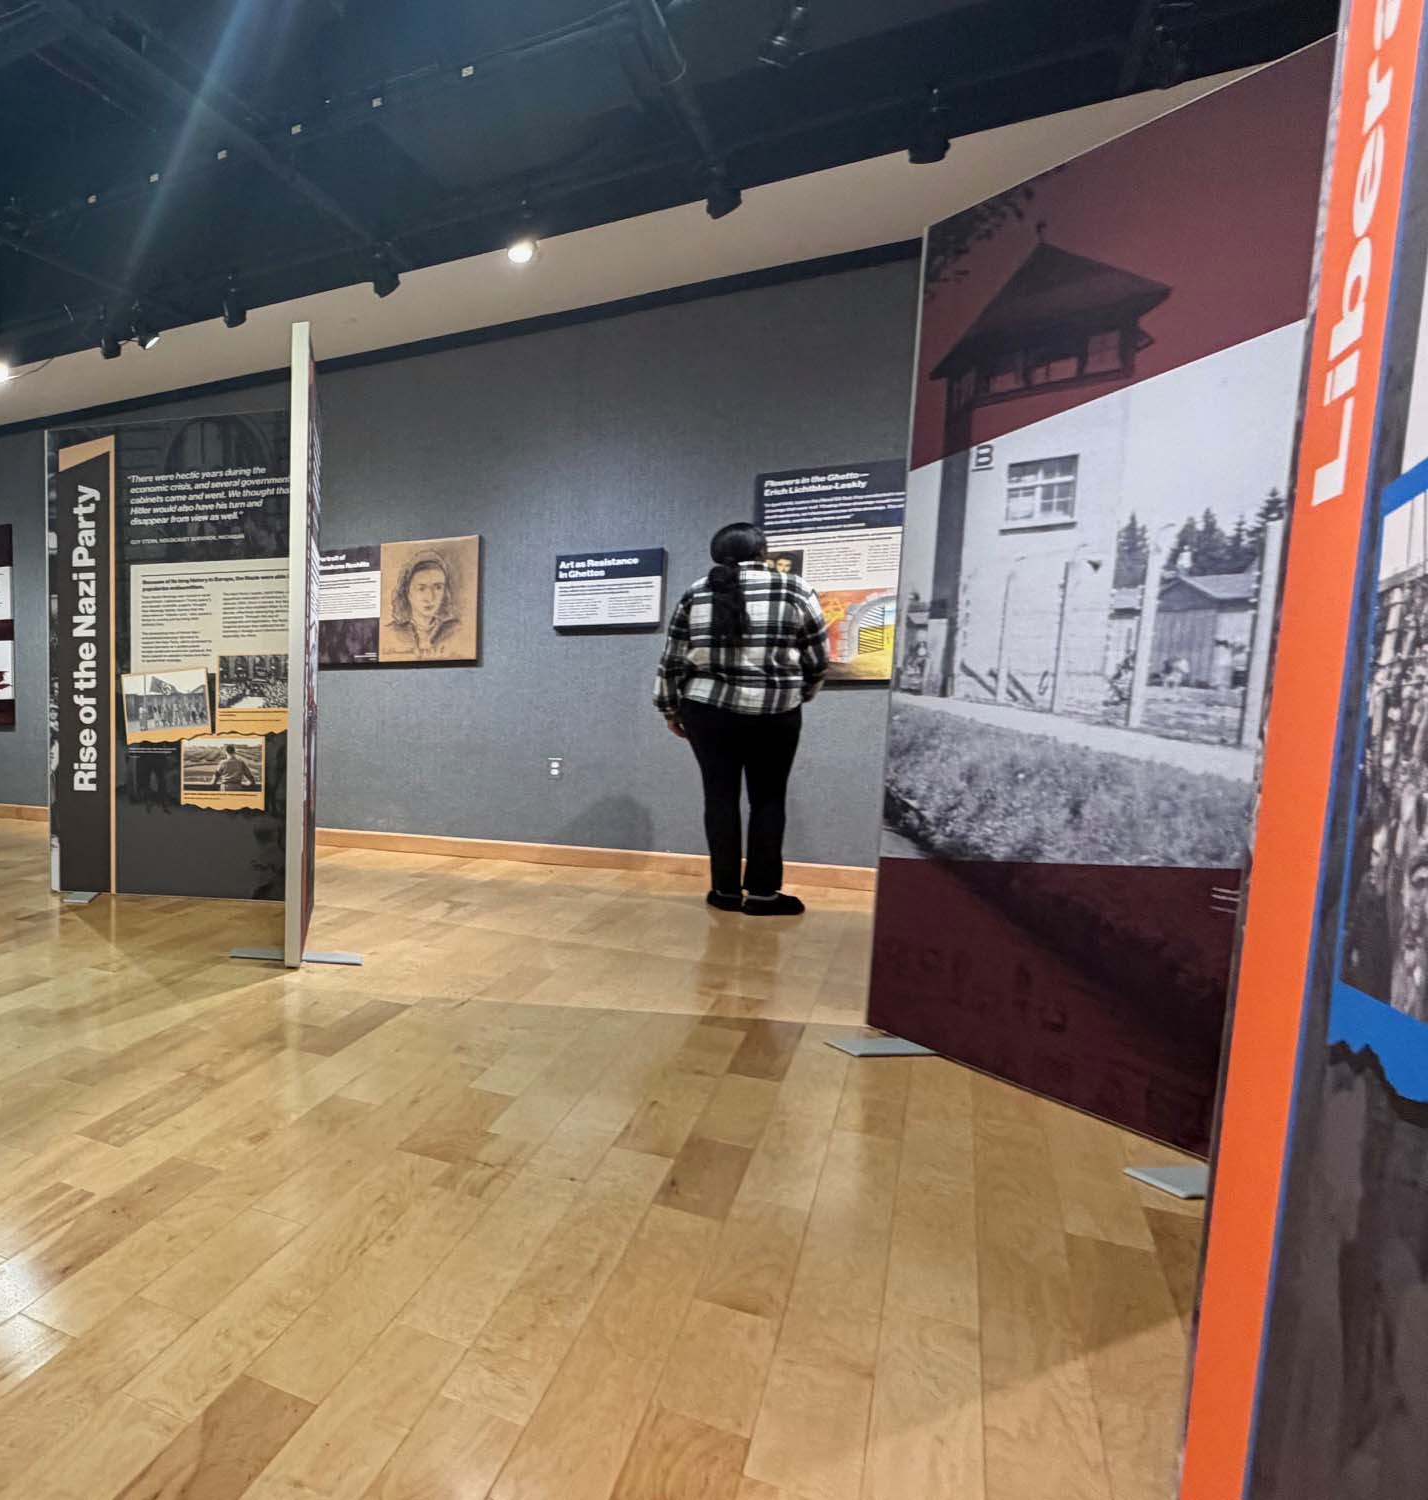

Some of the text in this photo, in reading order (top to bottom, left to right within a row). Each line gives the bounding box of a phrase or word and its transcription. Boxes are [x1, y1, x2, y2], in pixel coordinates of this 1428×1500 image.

[974, 444, 994, 467] B
[211, 478, 240, 488] several
[559, 560, 574, 570] Art
[587, 557, 639, 568] Resistance
[568, 569, 606, 579] Ghettos
[72, 484, 101, 792] Rise of the Nazi Party
